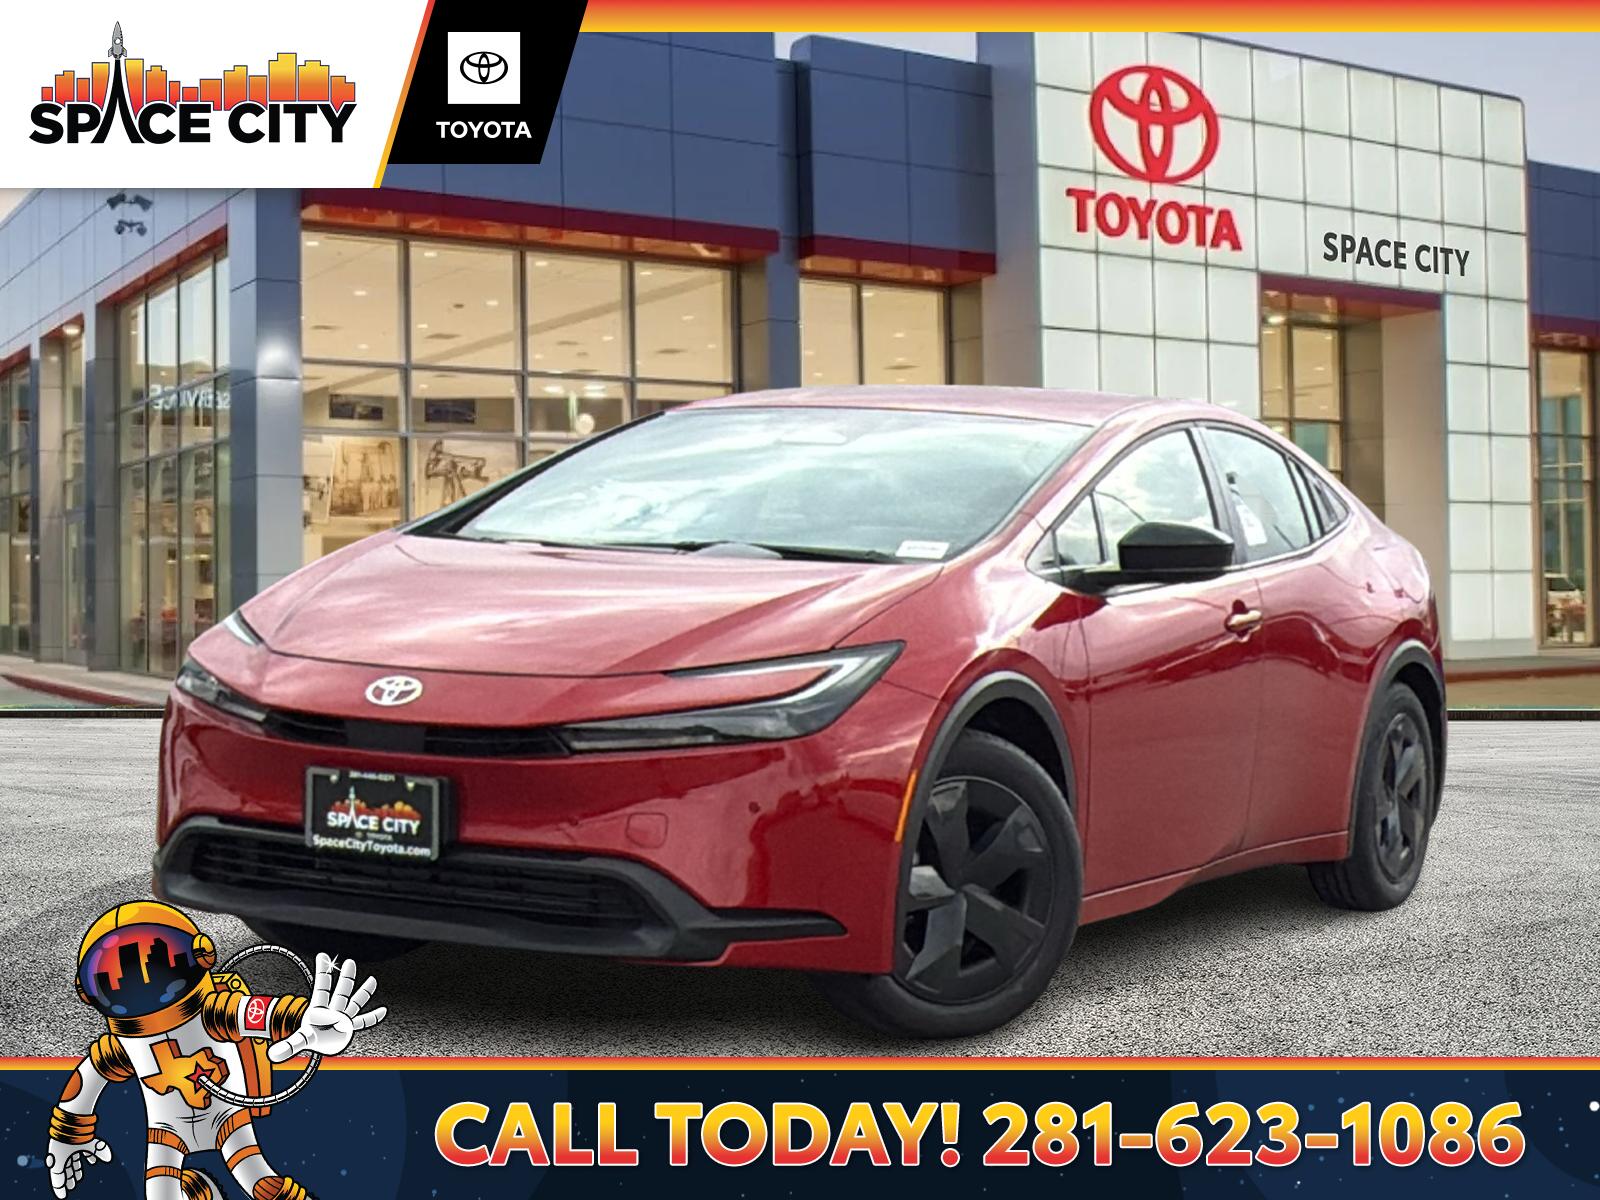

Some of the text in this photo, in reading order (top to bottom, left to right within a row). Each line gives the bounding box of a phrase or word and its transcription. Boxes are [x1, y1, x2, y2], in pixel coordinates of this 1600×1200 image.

[1066, 187, 1242, 251] TOYOTA
[1323, 232, 1470, 277] SPACE CITY
[327, 808, 420, 836] SPACE CITY
[312, 834, 431, 857] SpaceCityToyota.com
